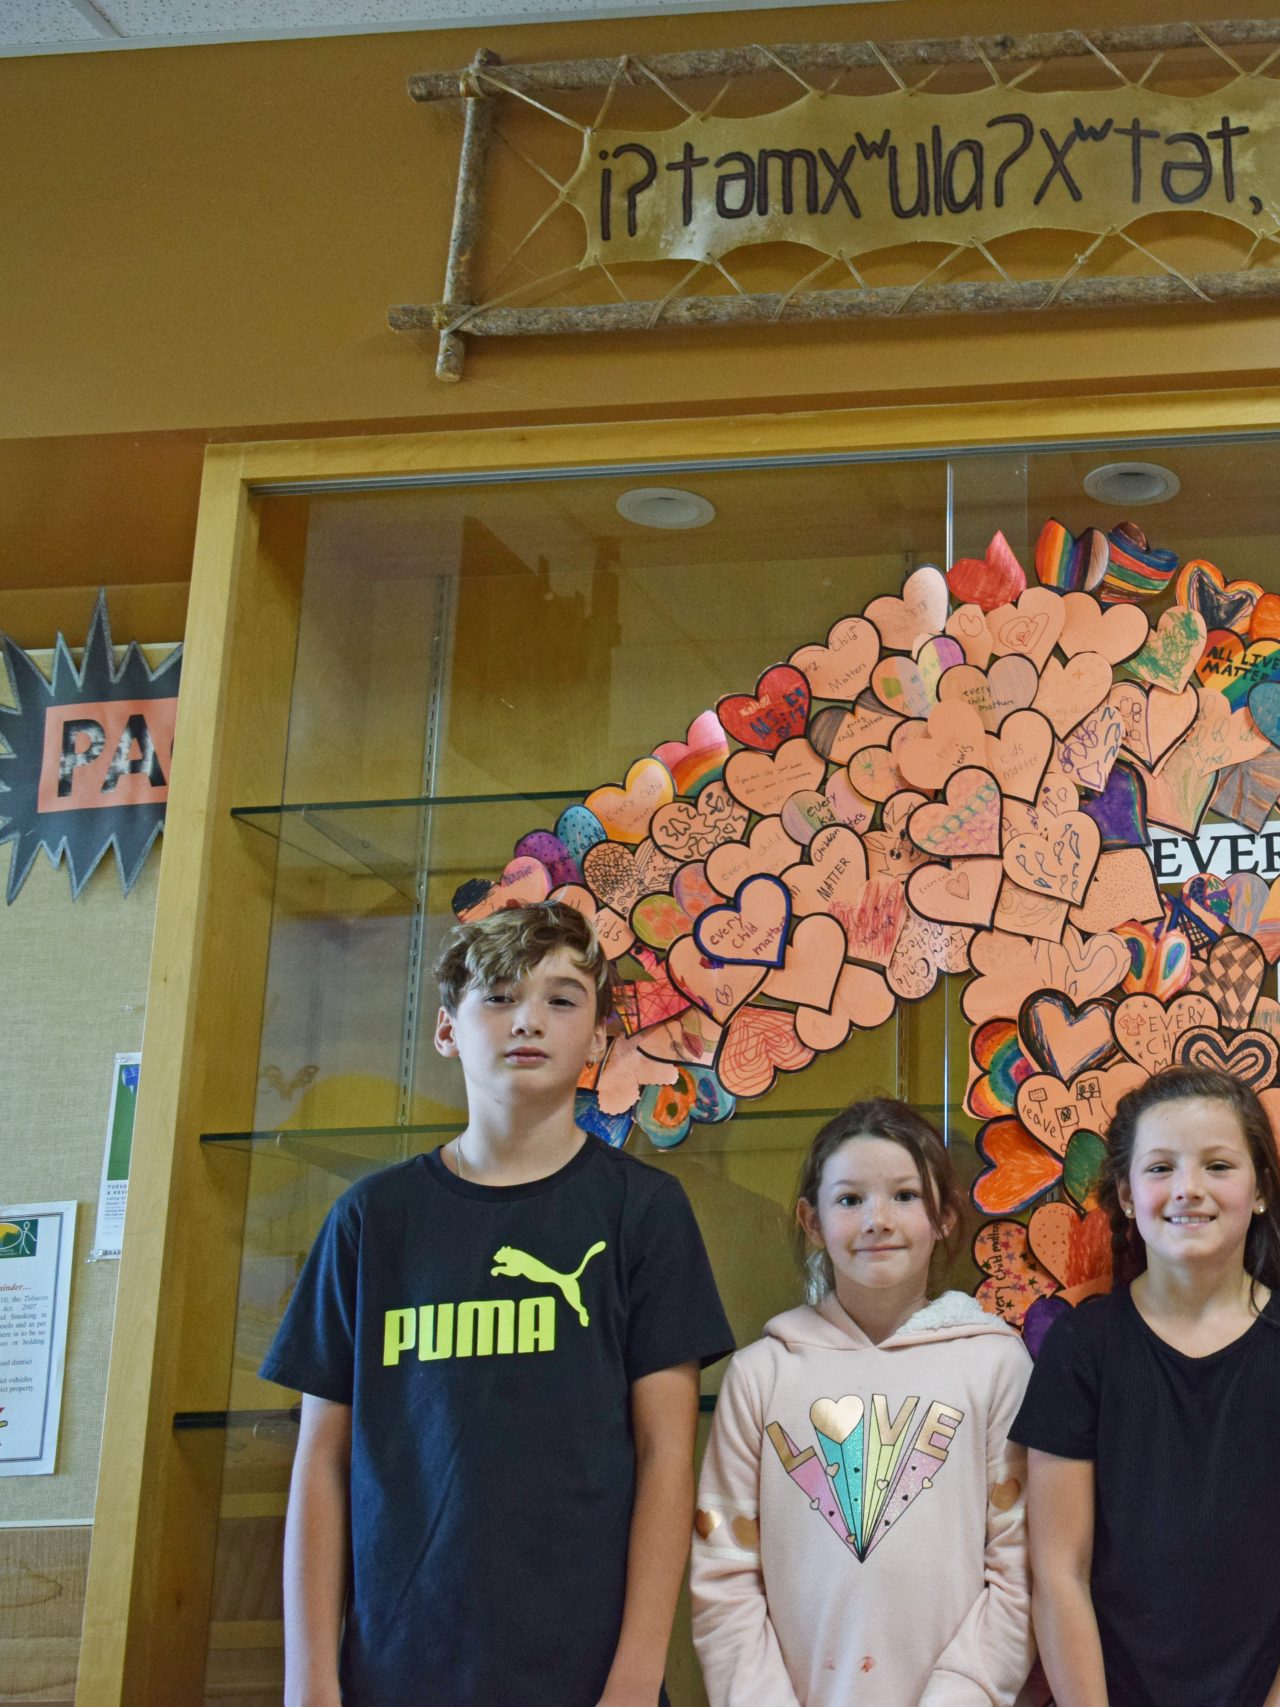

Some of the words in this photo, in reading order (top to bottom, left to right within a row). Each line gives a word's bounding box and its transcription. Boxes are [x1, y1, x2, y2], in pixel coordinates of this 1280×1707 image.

[1206, 646, 1233, 662] ALL
[806, 792, 838, 818] every
[816, 856, 851, 903] MATTER
[709, 913, 745, 946] every
[1149, 1005, 1206, 1033] EVERY
[1023, 1103, 1057, 1139] leave
[995, 1285, 1010, 1318] very
[383, 1296, 556, 1366] PUMA
